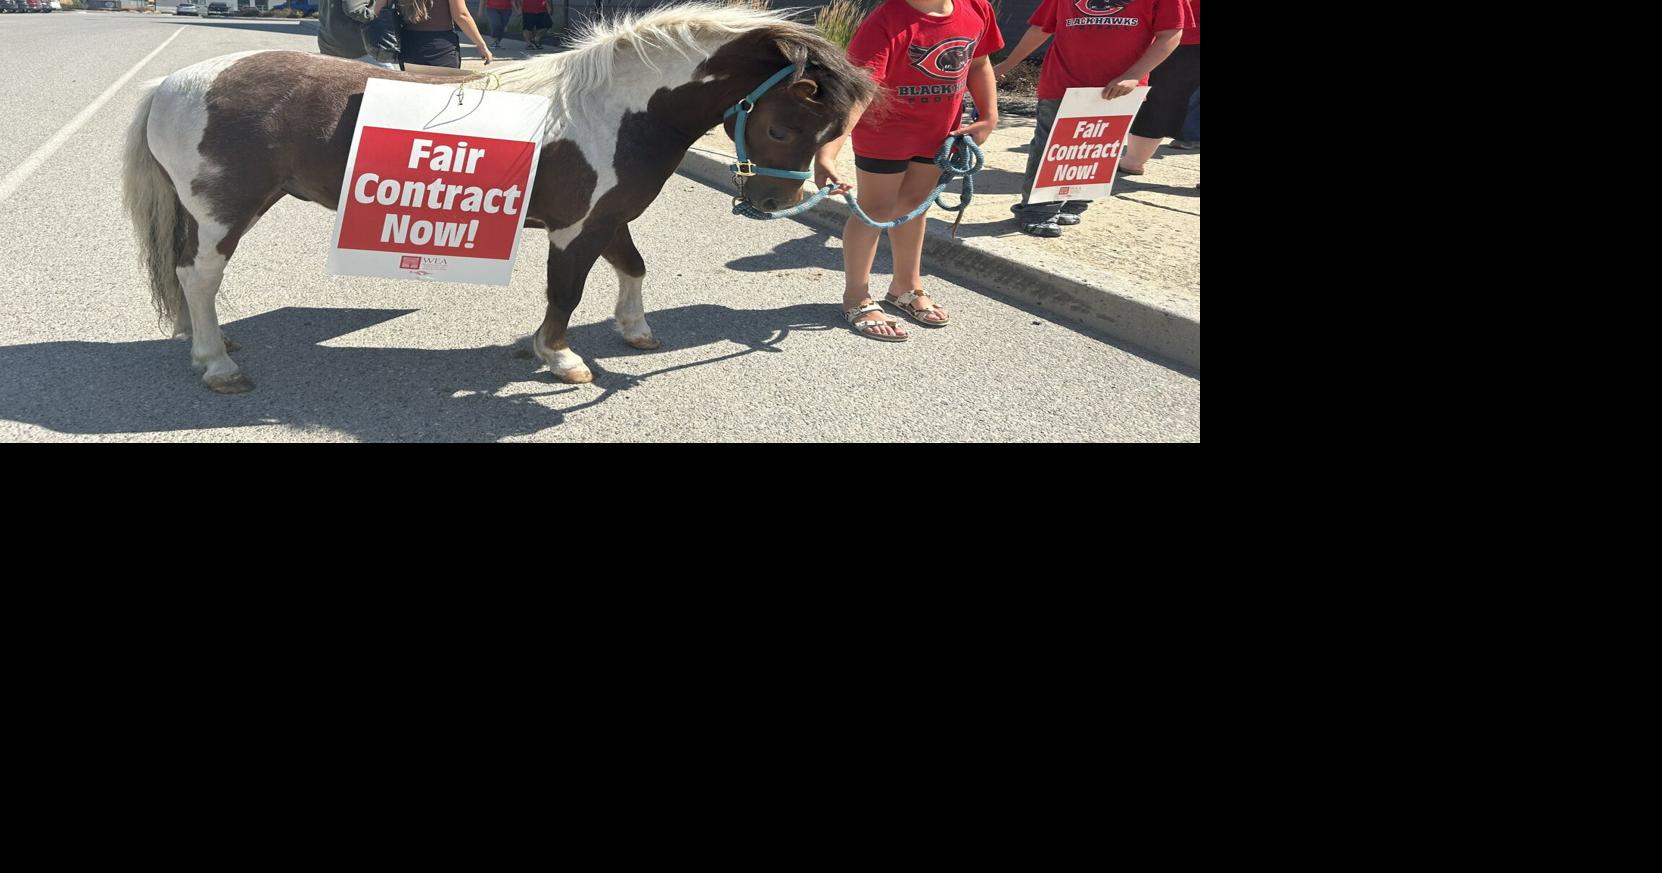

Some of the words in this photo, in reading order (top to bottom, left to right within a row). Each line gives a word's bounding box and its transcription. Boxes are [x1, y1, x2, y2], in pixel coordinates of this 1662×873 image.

[1073, 120, 1110, 139] Fair
[408, 138, 486, 174] Fair
[1047, 140, 1120, 162] Contract
[1053, 162, 1099, 182] Now!
[354, 173, 521, 215] Contract
[380, 213, 479, 249] Now!
